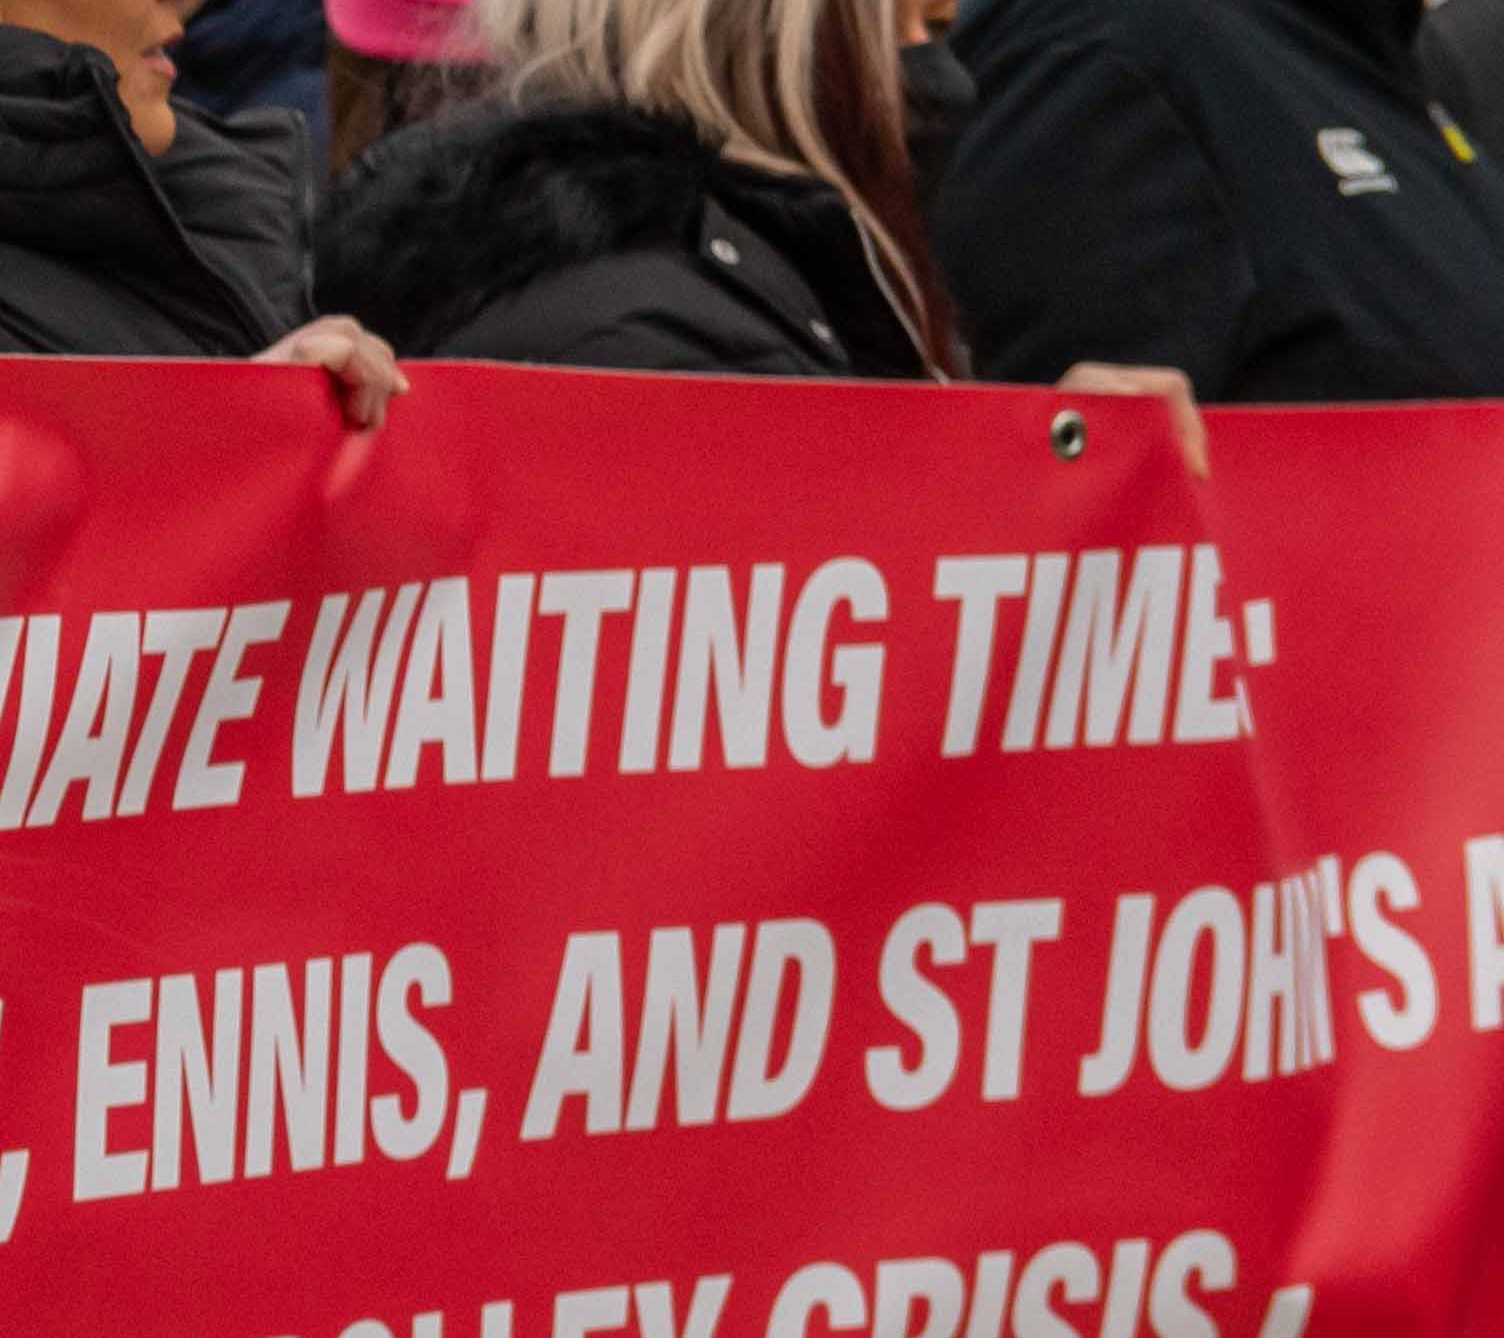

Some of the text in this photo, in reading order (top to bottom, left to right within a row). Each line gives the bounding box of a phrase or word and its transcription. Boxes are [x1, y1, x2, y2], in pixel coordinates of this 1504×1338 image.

[291, 555, 888, 799] WAITING
[933, 543, 1256, 759] TIME
[73, 942, 487, 1203] ENNIS,
[519, 917, 838, 1142] AND
[864, 898, 1063, 1112] ST
